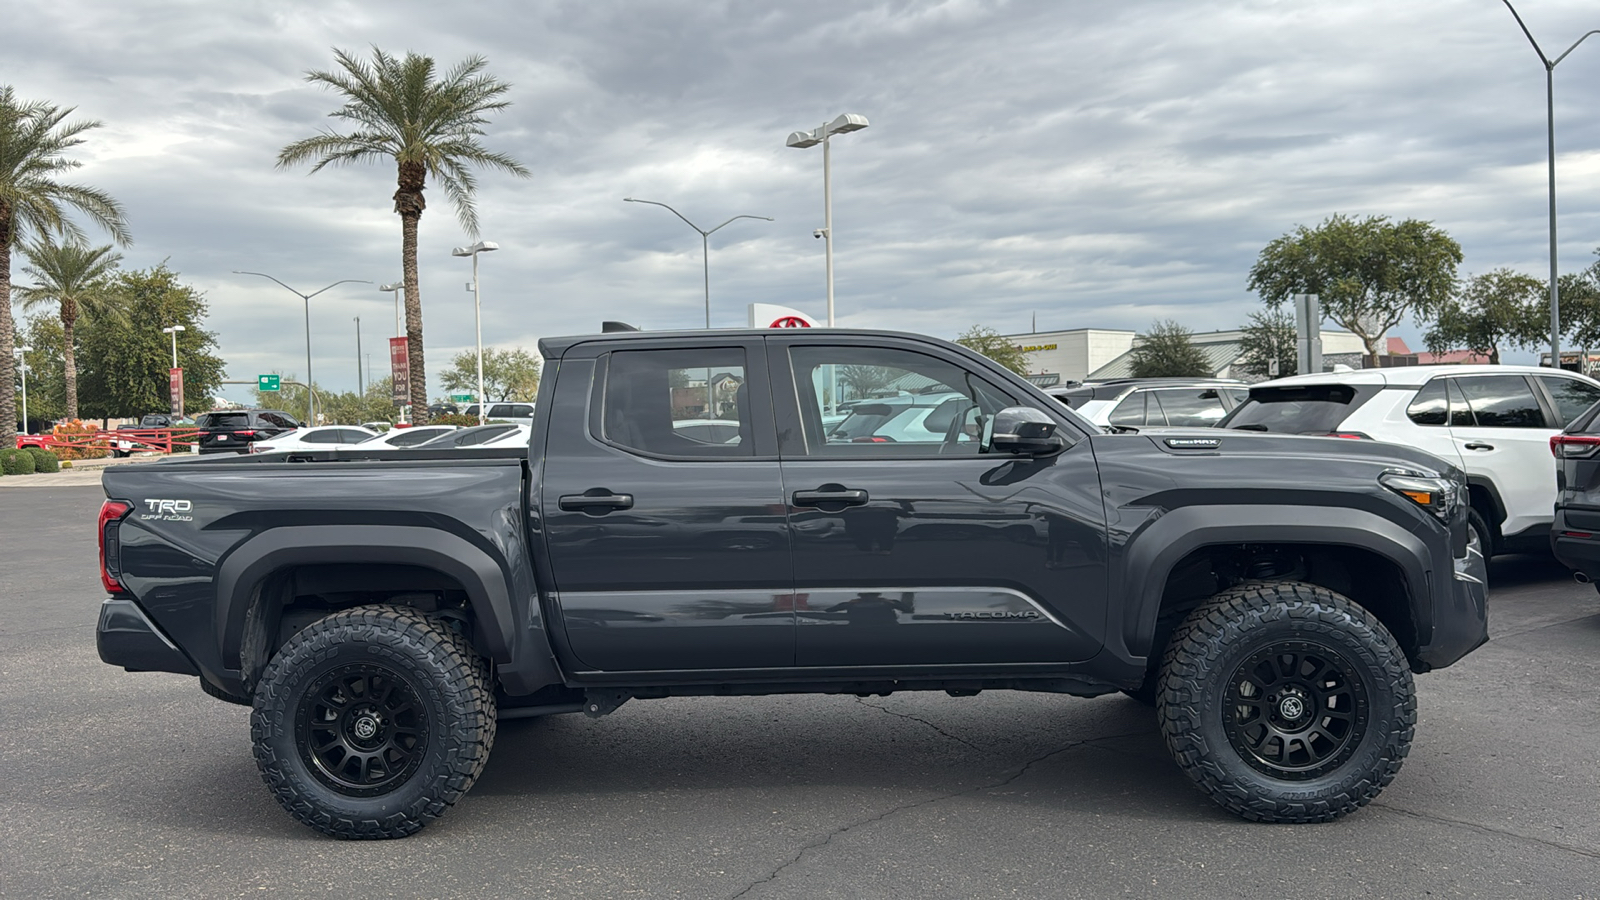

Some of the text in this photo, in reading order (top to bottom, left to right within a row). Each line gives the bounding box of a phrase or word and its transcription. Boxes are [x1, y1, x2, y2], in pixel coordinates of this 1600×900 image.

[394, 372, 406, 380] YOU
[144, 498, 192, 514] TRD
[944, 610, 1039, 620] TACOMA
